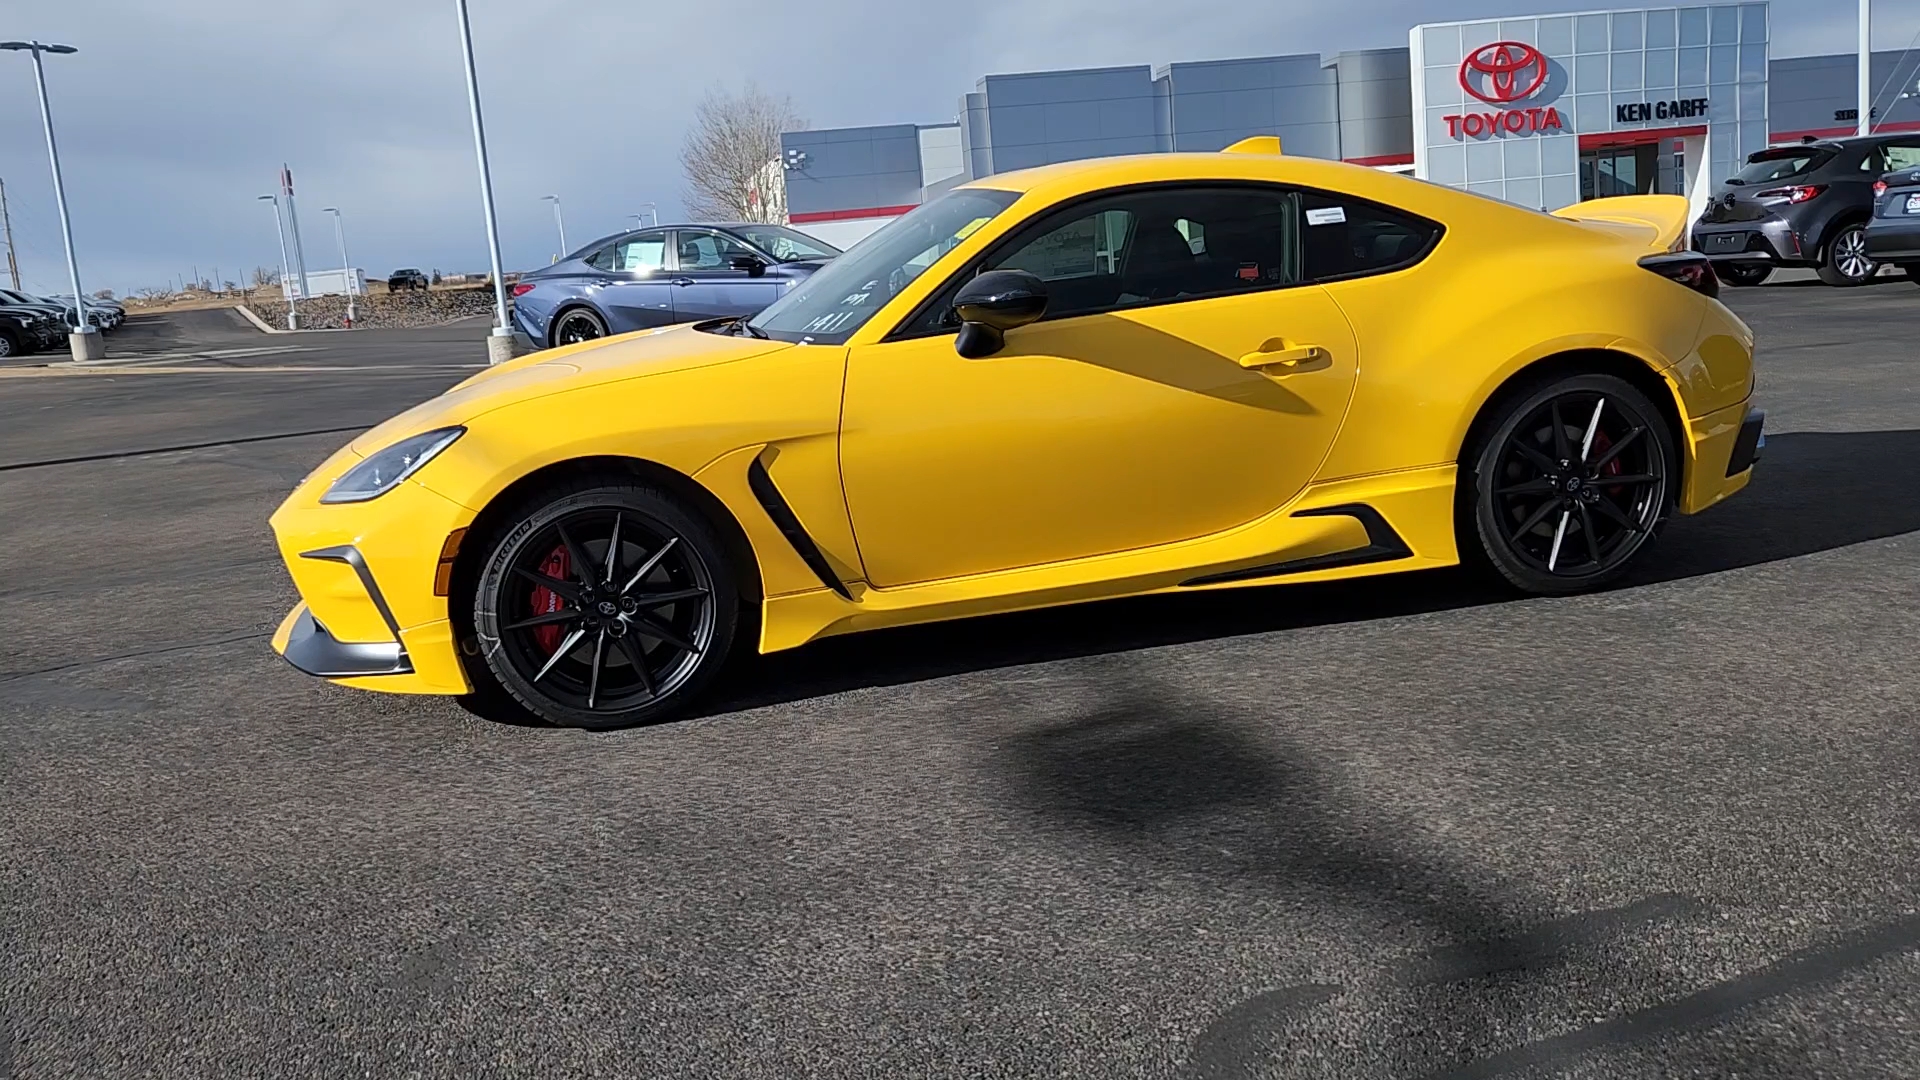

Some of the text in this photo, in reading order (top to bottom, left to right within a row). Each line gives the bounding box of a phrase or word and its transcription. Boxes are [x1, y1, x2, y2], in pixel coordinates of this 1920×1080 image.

[1442, 107, 1563, 137] TOYOTA
[1616, 98, 1708, 123] KEN GARFF
[493, 522, 530, 571] MICHELIN
